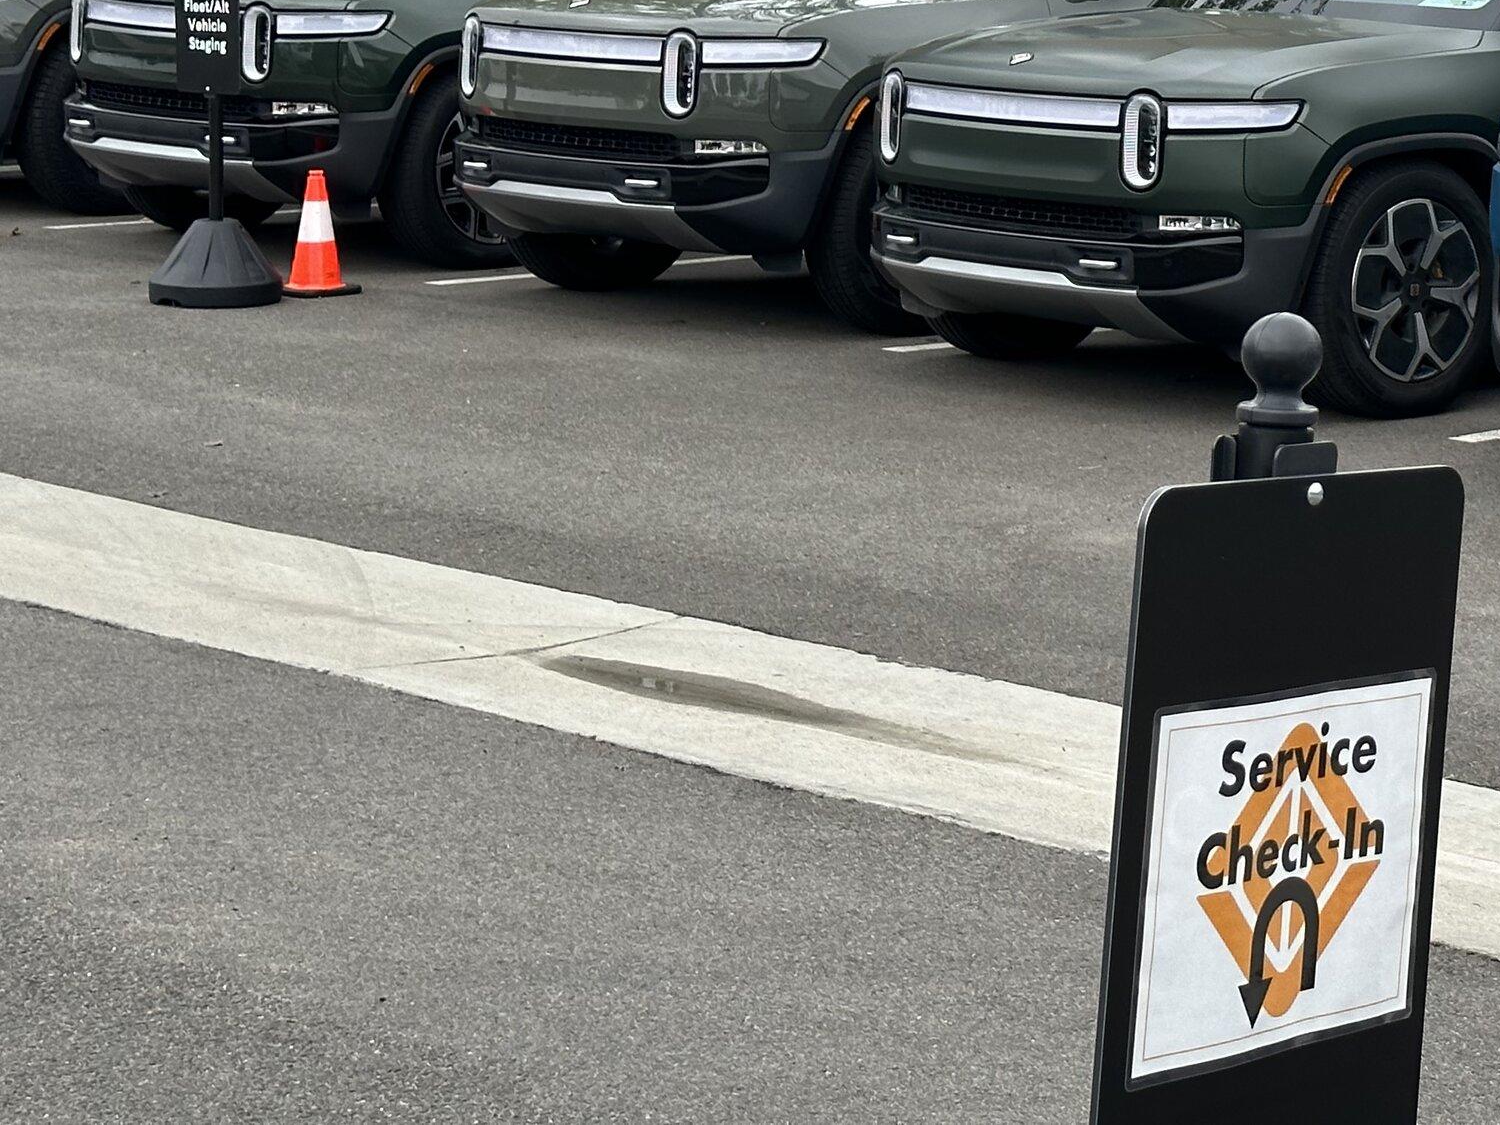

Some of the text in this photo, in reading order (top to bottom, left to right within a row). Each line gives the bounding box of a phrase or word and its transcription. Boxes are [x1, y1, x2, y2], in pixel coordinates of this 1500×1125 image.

[187, 17, 227, 33] Vehicle
[188, 36, 227, 55] Staging
[1218, 722, 1377, 797] Service
[1196, 806, 1385, 889] Check-In
